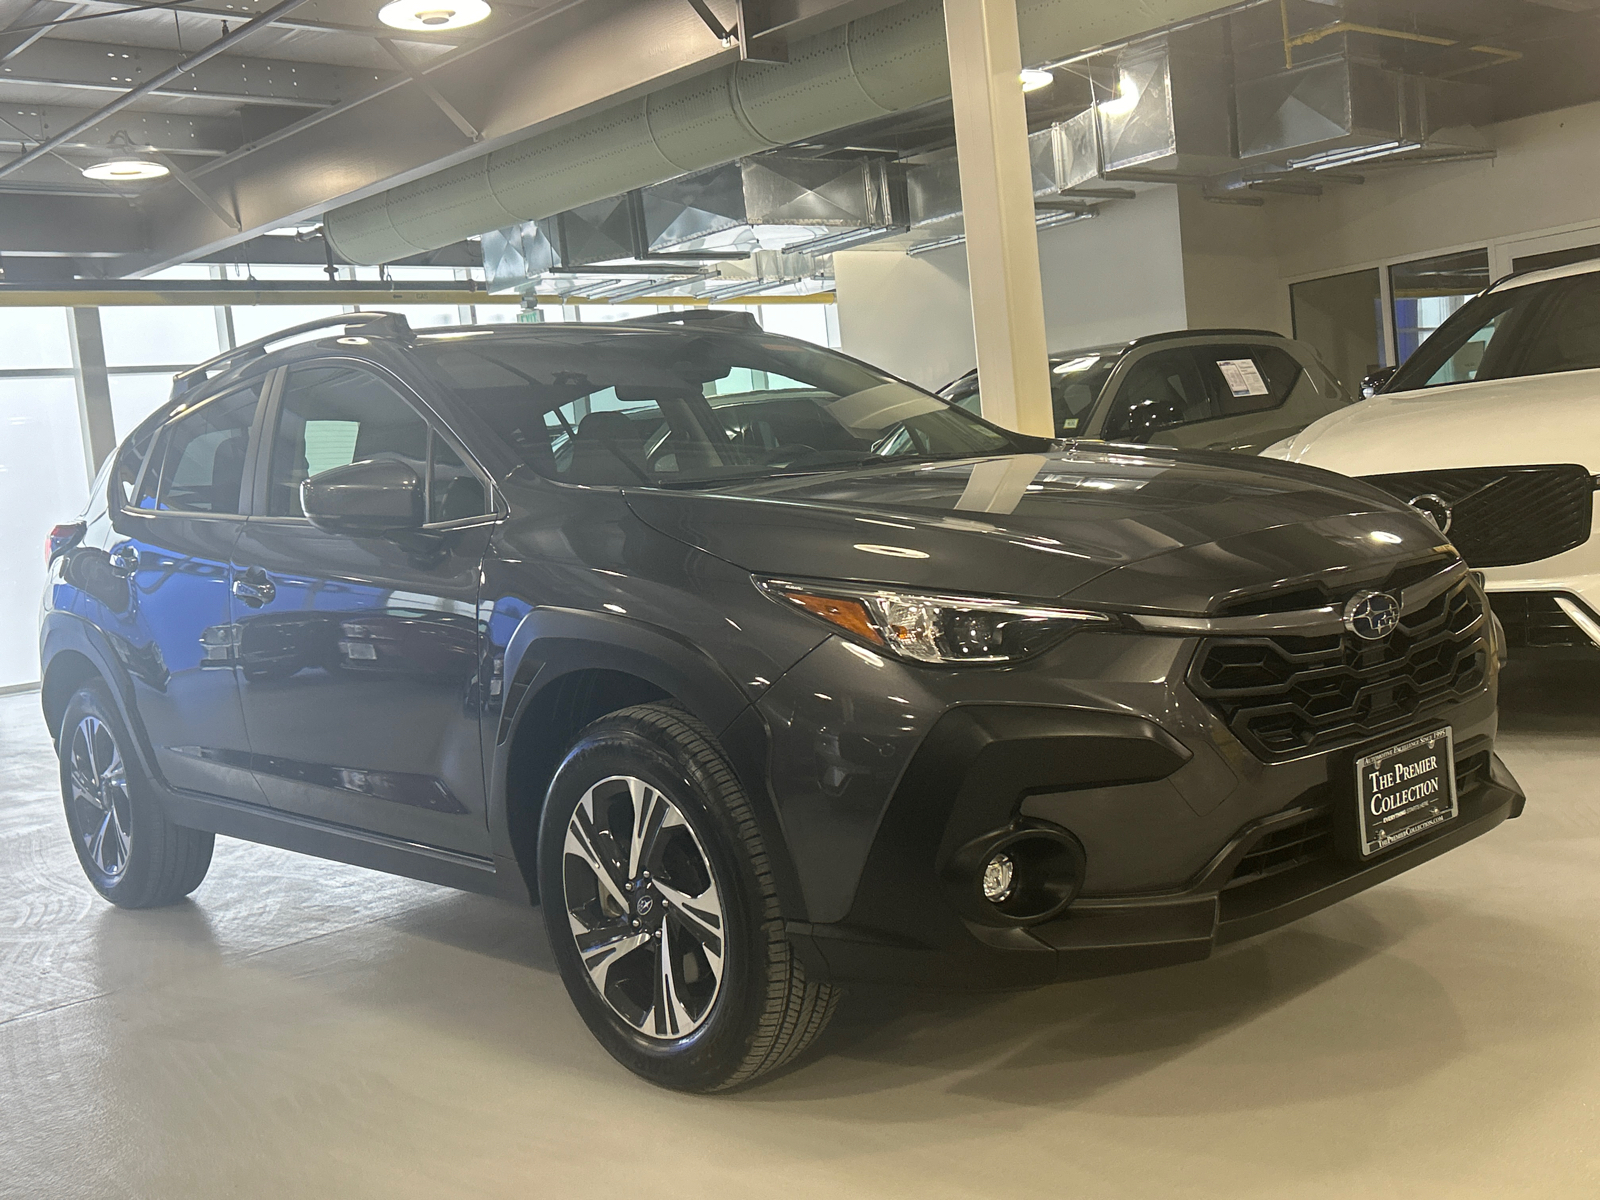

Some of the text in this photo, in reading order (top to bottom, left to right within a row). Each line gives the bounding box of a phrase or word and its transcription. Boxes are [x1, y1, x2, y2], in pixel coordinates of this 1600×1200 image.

[520, 311, 537, 323] EXIT
[1369, 756, 1438, 793] THE PREMIER
[1371, 777, 1439, 816] COLLECTION
